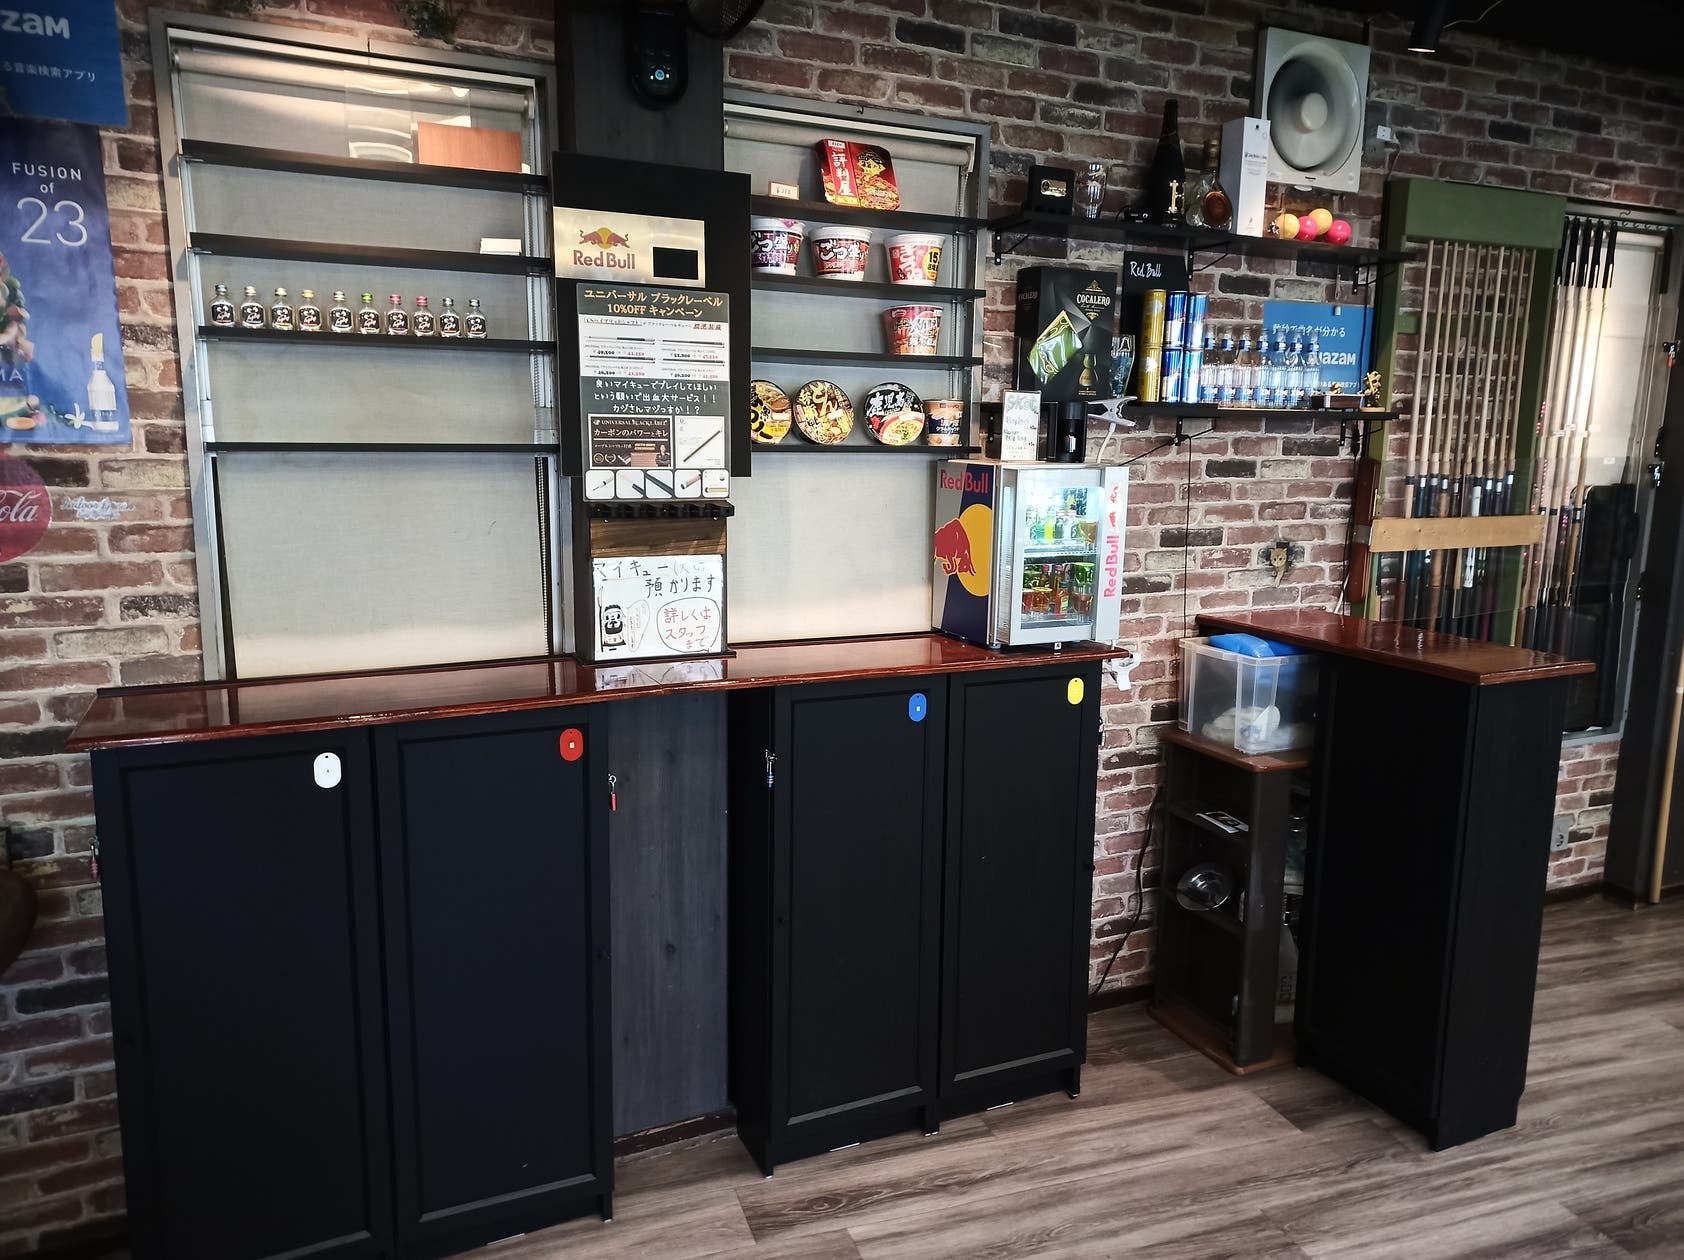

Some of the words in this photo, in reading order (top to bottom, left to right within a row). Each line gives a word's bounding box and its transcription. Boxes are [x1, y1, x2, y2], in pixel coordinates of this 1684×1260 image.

[12, 162, 82, 181] FUSION
[40, 182, 55, 194] of
[17, 197, 88, 247] 23
[573, 249, 604, 267] Red
[606, 252, 636, 270] Bull
[1129, 260, 1145, 278] Red
[1146, 262, 1162, 278] Bull
[584, 289, 648, 303] ユニバーサル
[650, 291, 724, 308] ブラックレーベル
[1076, 293, 1112, 307] COCALERO
[607, 303, 647, 315] 10%OFF
[649, 305, 703, 318] キャンペーン
[940, 469, 964, 490] Red
[964, 471, 989, 494] Bull
[1105, 535, 1120, 565] Bull
[645, 574, 715, 598] 預かります
[1103, 567, 1118, 598] Red
[664, 606, 711, 623] 詳しくは
[665, 625, 706, 640] スタッフ
[686, 636, 709, 649] まで
